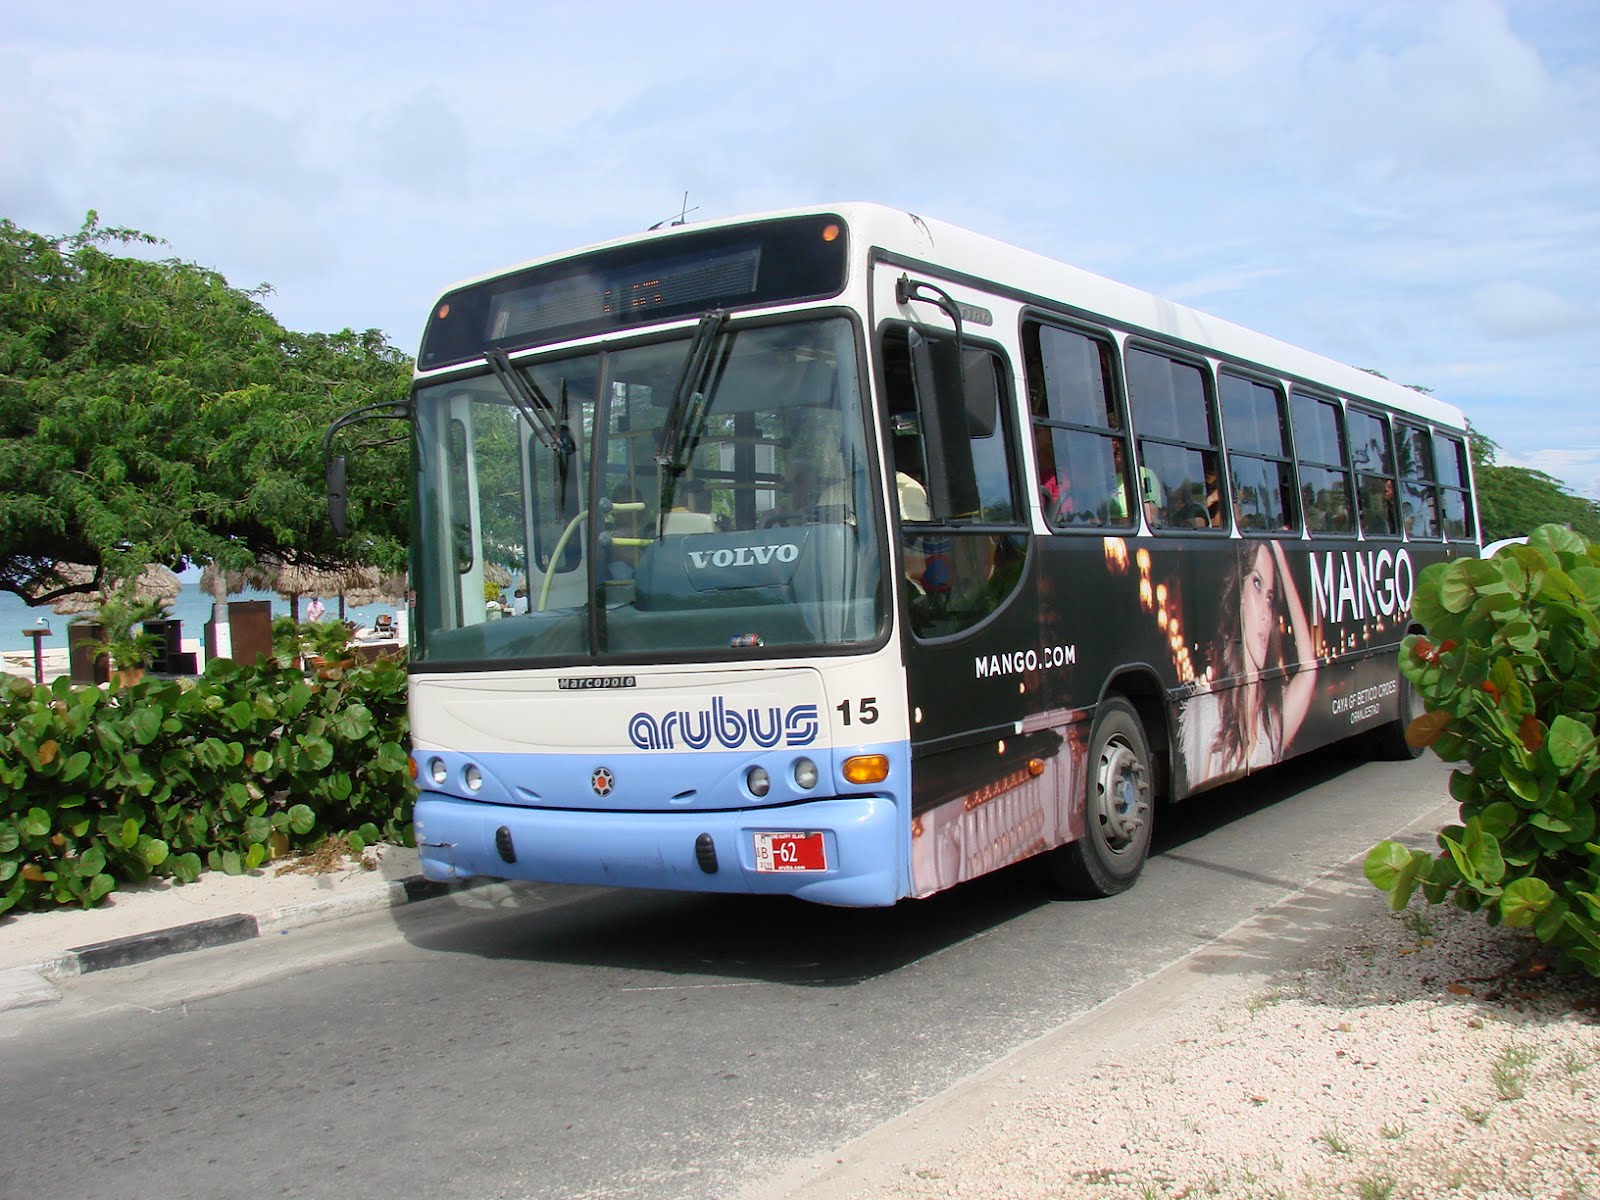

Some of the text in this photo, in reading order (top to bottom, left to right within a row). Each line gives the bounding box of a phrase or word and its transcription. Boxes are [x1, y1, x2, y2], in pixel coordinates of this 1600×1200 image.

[688, 543, 799, 569] VOLVO
[1309, 548, 1413, 627] MANGO
[975, 644, 1076, 679] MANGO.COM
[559, 676, 634, 689] Marcopolo
[1331, 697, 1349, 715] CAYA
[1377, 679, 1396, 698] CROES
[627, 695, 819, 750] arubus
[836, 697, 880, 727] 15
